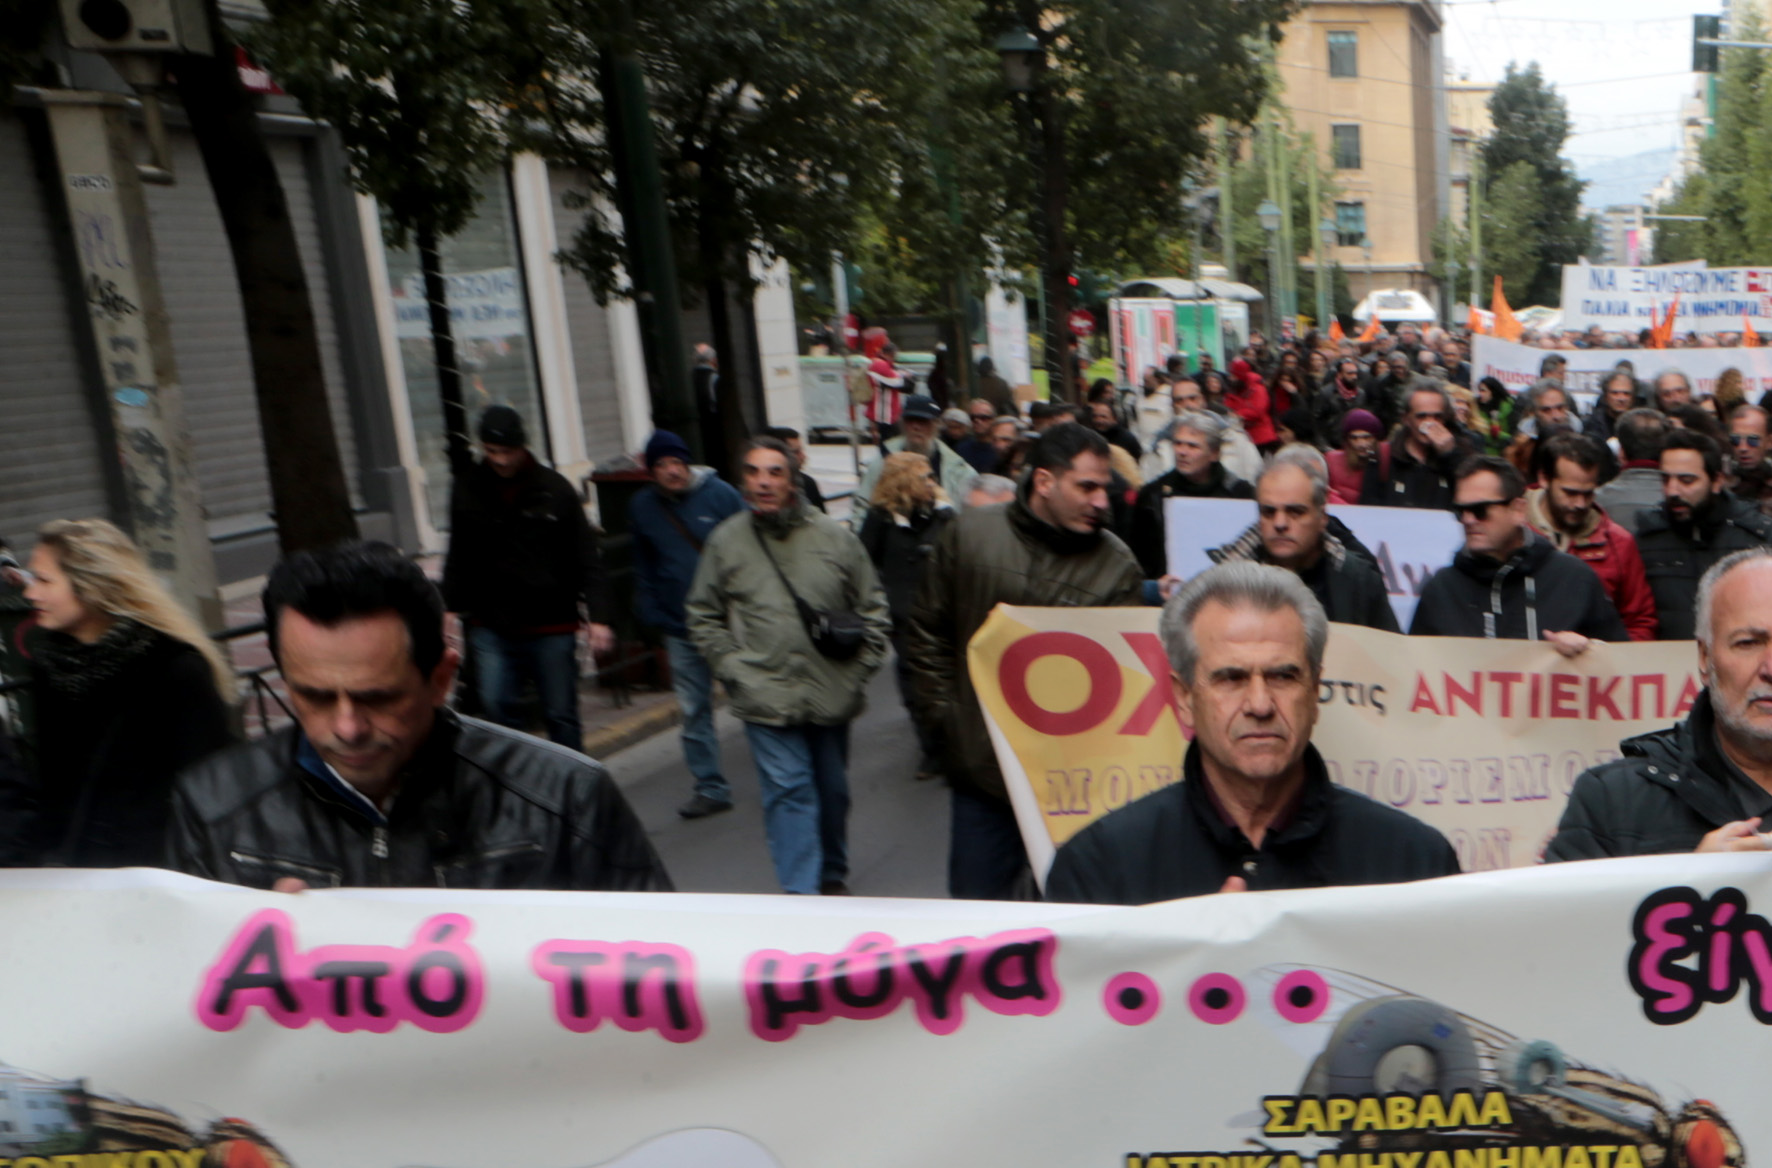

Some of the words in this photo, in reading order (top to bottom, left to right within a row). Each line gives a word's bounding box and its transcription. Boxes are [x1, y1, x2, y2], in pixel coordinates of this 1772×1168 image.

[196, 908, 486, 1033] Από
[531, 938, 706, 1043] τη
[1262, 1090, 1514, 1137] ΣΑΡΑΒΑΛΑ
